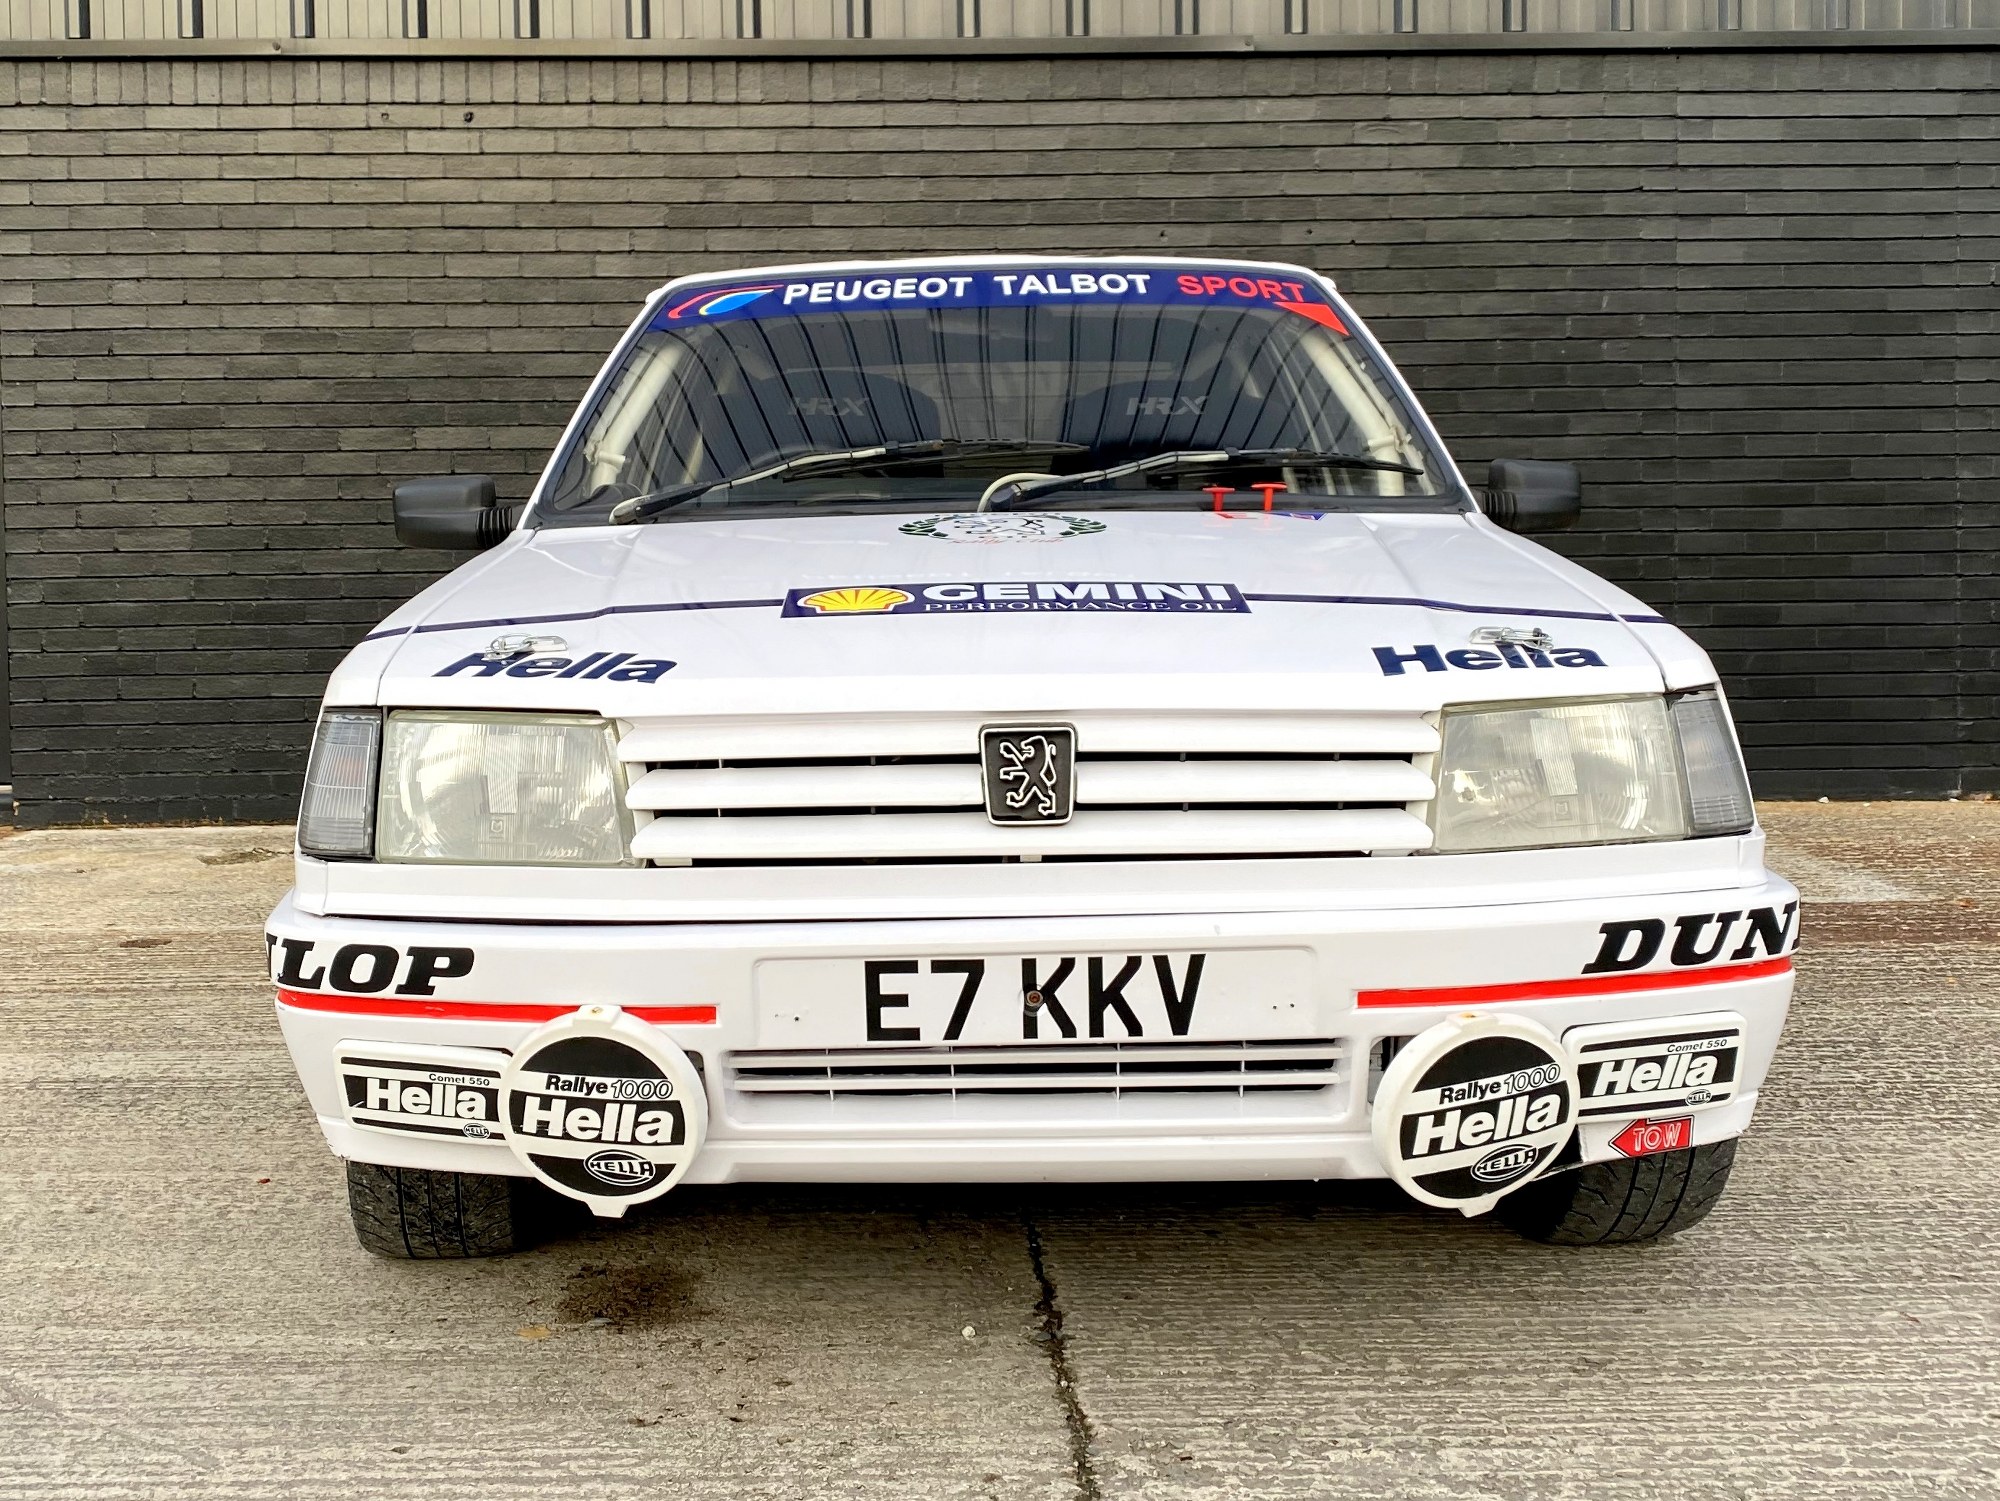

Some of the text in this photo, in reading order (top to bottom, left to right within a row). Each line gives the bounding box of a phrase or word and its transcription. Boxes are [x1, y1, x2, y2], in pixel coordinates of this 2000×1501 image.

[783, 274, 1304, 305] PEUGEOT TALBOT SPORT
[787, 397, 870, 416] HRX
[1126, 395, 1207, 415] HRX
[922, 583, 1232, 601] GEMINI
[924, 601, 1238, 611] PERFORMANCE OIL
[431, 652, 678, 684] Hella
[1371, 641, 1609, 676] Hella
[1580, 900, 1800, 975] DUN
[864, 953, 1206, 1042] E7 KKV
[1667, 1038, 1728, 1053] Comet 550
[428, 1073, 491, 1087] Comet 550
[545, 1074, 674, 1100] Rallye 1000
[1439, 1063, 1561, 1106] Rallye 1000
[1593, 1052, 1718, 1097] Hella
[366, 1077, 487, 1121] Hella
[1688, 1091, 1712, 1102] HELLA
[464, 1124, 490, 1137] HELLA
[522, 1095, 674, 1145] Hella
[1412, 1093, 1561, 1156] Hella
[1633, 1122, 1682, 1152] TOW
[590, 1159, 654, 1178] HELLA
[1475, 1149, 1536, 1174] HELLA
